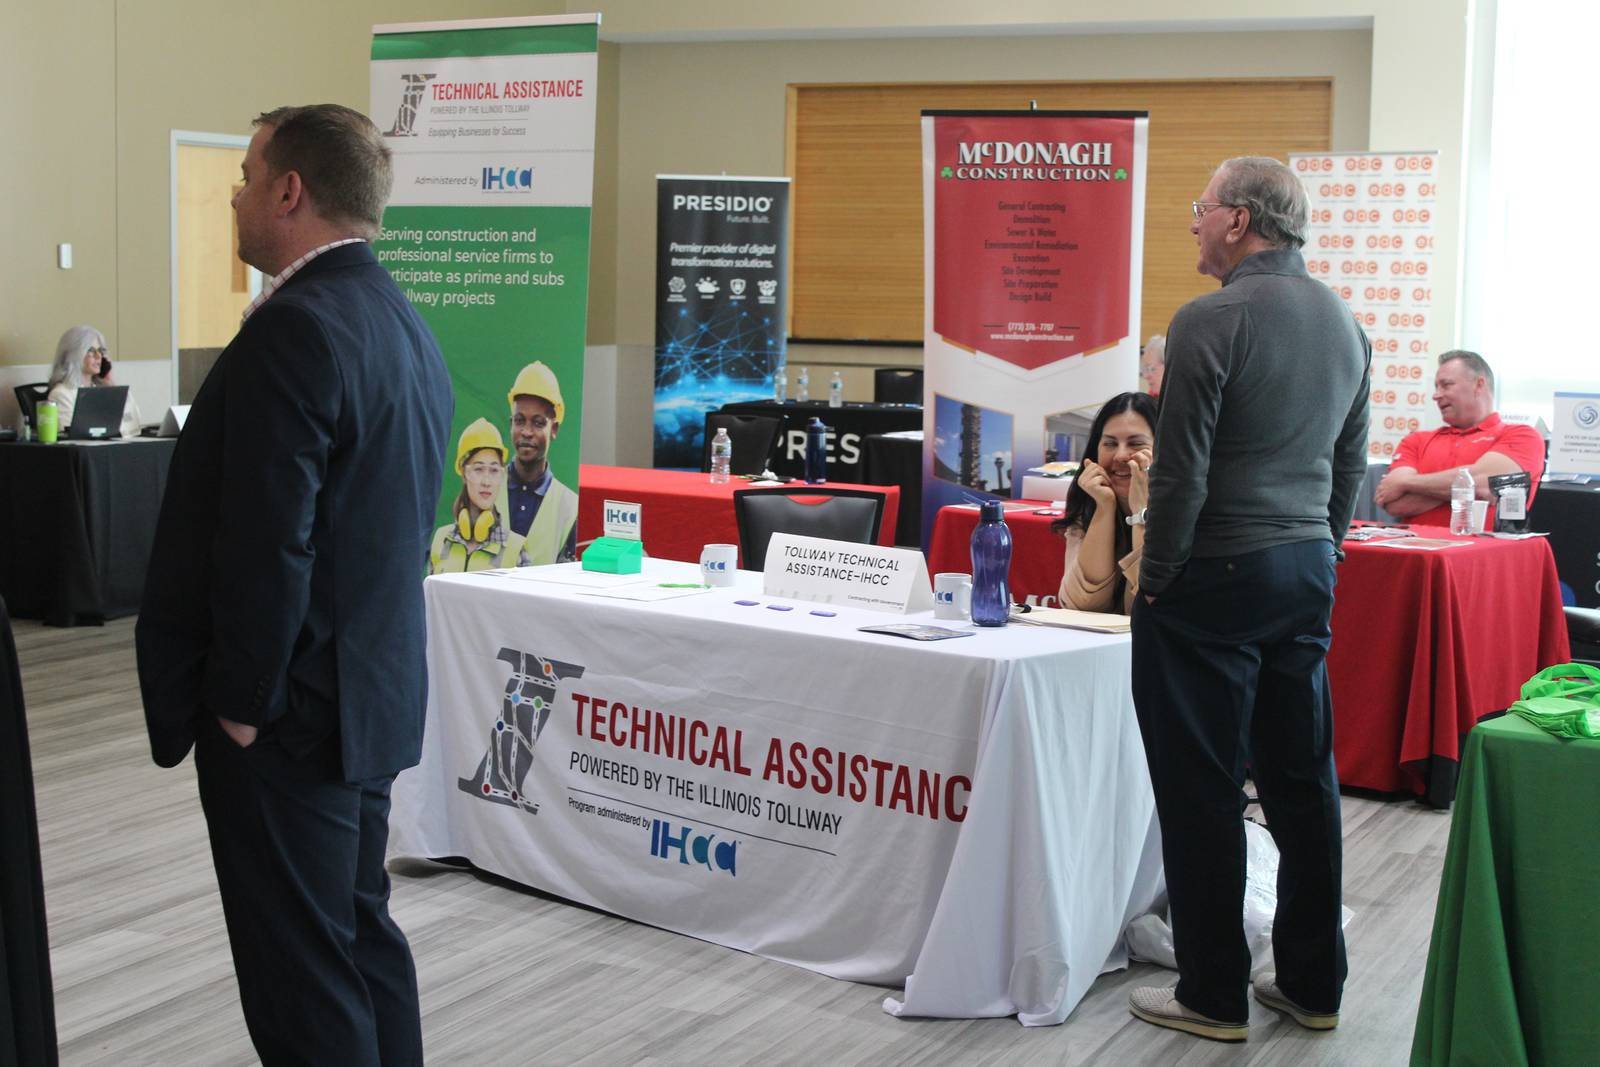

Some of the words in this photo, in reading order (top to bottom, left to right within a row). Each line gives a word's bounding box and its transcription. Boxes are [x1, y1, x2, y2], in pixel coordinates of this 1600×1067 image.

[432, 82, 499, 100] TECHNICAL
[503, 79, 583, 99] ASSISTANCE
[430, 106, 457, 115] POWERED
[458, 105, 467, 114] BY
[468, 105, 479, 114] THE
[480, 105, 503, 114] ILLINOIS
[504, 104, 530, 113] TOLLWAY
[502, 126, 526, 136] Success
[414, 175, 467, 185] Administered
[469, 175, 479, 187] by
[482, 167, 533, 190] IHCC
[957, 167, 1111, 180] CONSTRUCTION
[673, 194, 771, 212] PRESIDIO
[379, 227, 423, 244] Serving
[426, 228, 508, 242] construction
[512, 228, 537, 242] and
[378, 248, 452, 266] professional
[455, 249, 500, 263] service
[503, 249, 536, 264] firms
[540, 250, 554, 264] to
[670, 242, 703, 253] Premier
[702, 243, 739, 255] provider
[739, 243, 751, 254] of
[749, 243, 777, 256] digital
[671, 256, 733, 267] transformation
[390, 267, 443, 285] rticipate
[446, 272, 461, 283] as
[464, 270, 502, 286] prime
[505, 271, 529, 285] and
[532, 271, 565, 286] subs
[443, 290, 496, 307] projects
[784, 545, 835, 562] TOLLWAY
[838, 552, 900, 571] TECHNICAL
[571, 692, 752, 776] TECHNICAL
[762, 737, 972, 823] ASSISTANC
[569, 751, 639, 787] POWERED
[644, 770, 663, 793] BY
[666, 775, 694, 801] THE
[699, 783, 761, 818] ILLINOIS
[766, 800, 842, 836] TOLLWAY
[568, 797, 596, 815] Program
[597, 805, 641, 826] administered
[642, 817, 651, 831] by
[650, 818, 737, 877] IHCC
